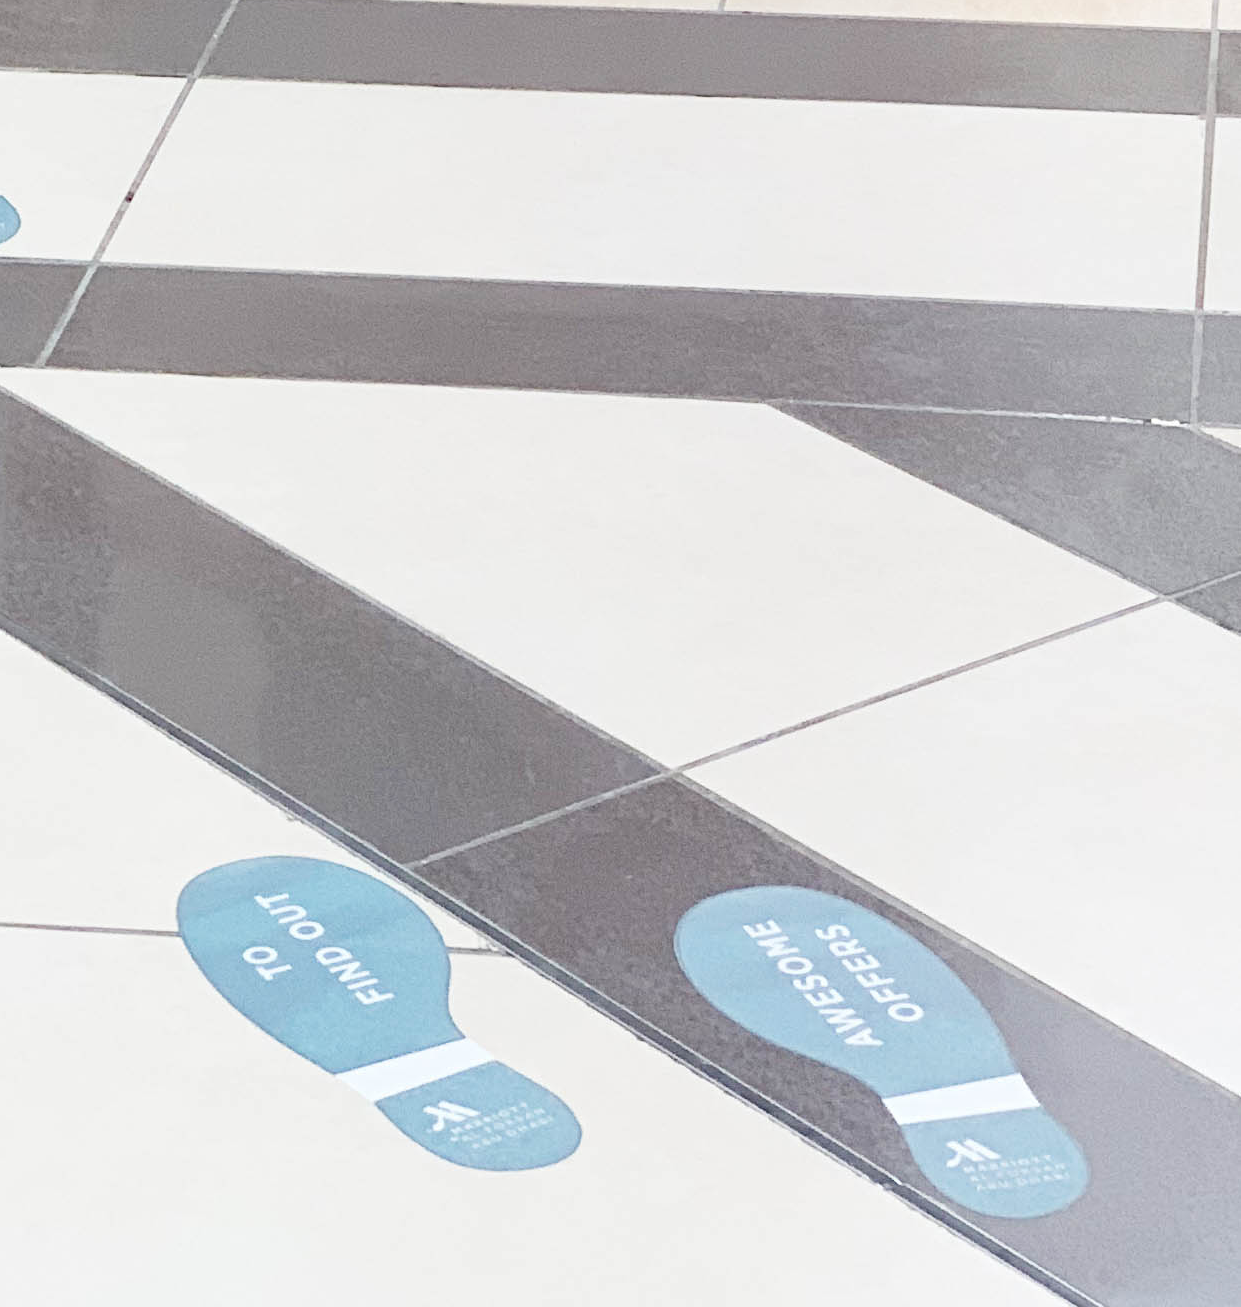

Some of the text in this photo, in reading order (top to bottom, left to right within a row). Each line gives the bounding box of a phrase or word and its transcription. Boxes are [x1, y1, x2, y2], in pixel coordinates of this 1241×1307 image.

[242, 946, 293, 982] TO
[254, 892, 395, 1007] FIND OUT
[743, 918, 884, 1048] AWESOME
[815, 923, 925, 1023] OFFERS
